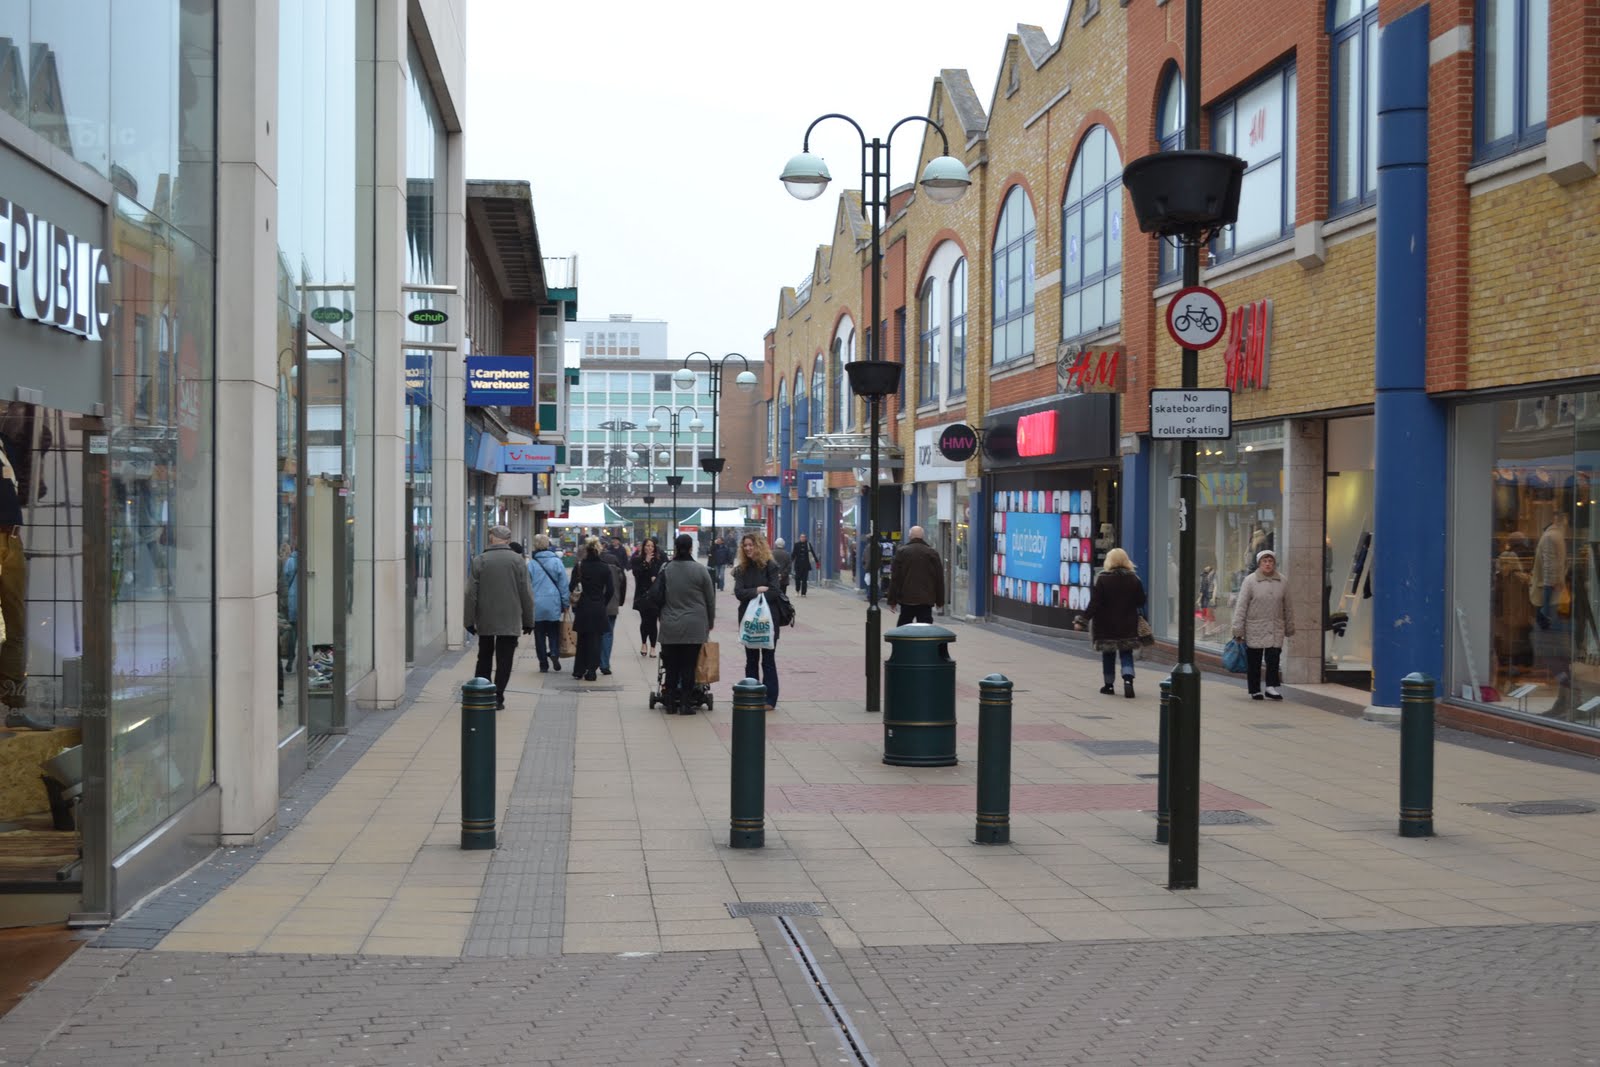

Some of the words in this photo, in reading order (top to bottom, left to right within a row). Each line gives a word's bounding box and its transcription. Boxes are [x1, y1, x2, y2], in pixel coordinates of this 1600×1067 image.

[413, 313, 444, 321] schuh
[1066, 351, 1119, 388] H&M
[476, 369, 530, 380] Carphone
[471, 380, 530, 389] Warehouse
[1184, 394, 1198, 402] No
[1155, 404, 1228, 414] skateboarding
[1159, 426, 1224, 435] rollerskating
[942, 437, 974, 449] HMV
